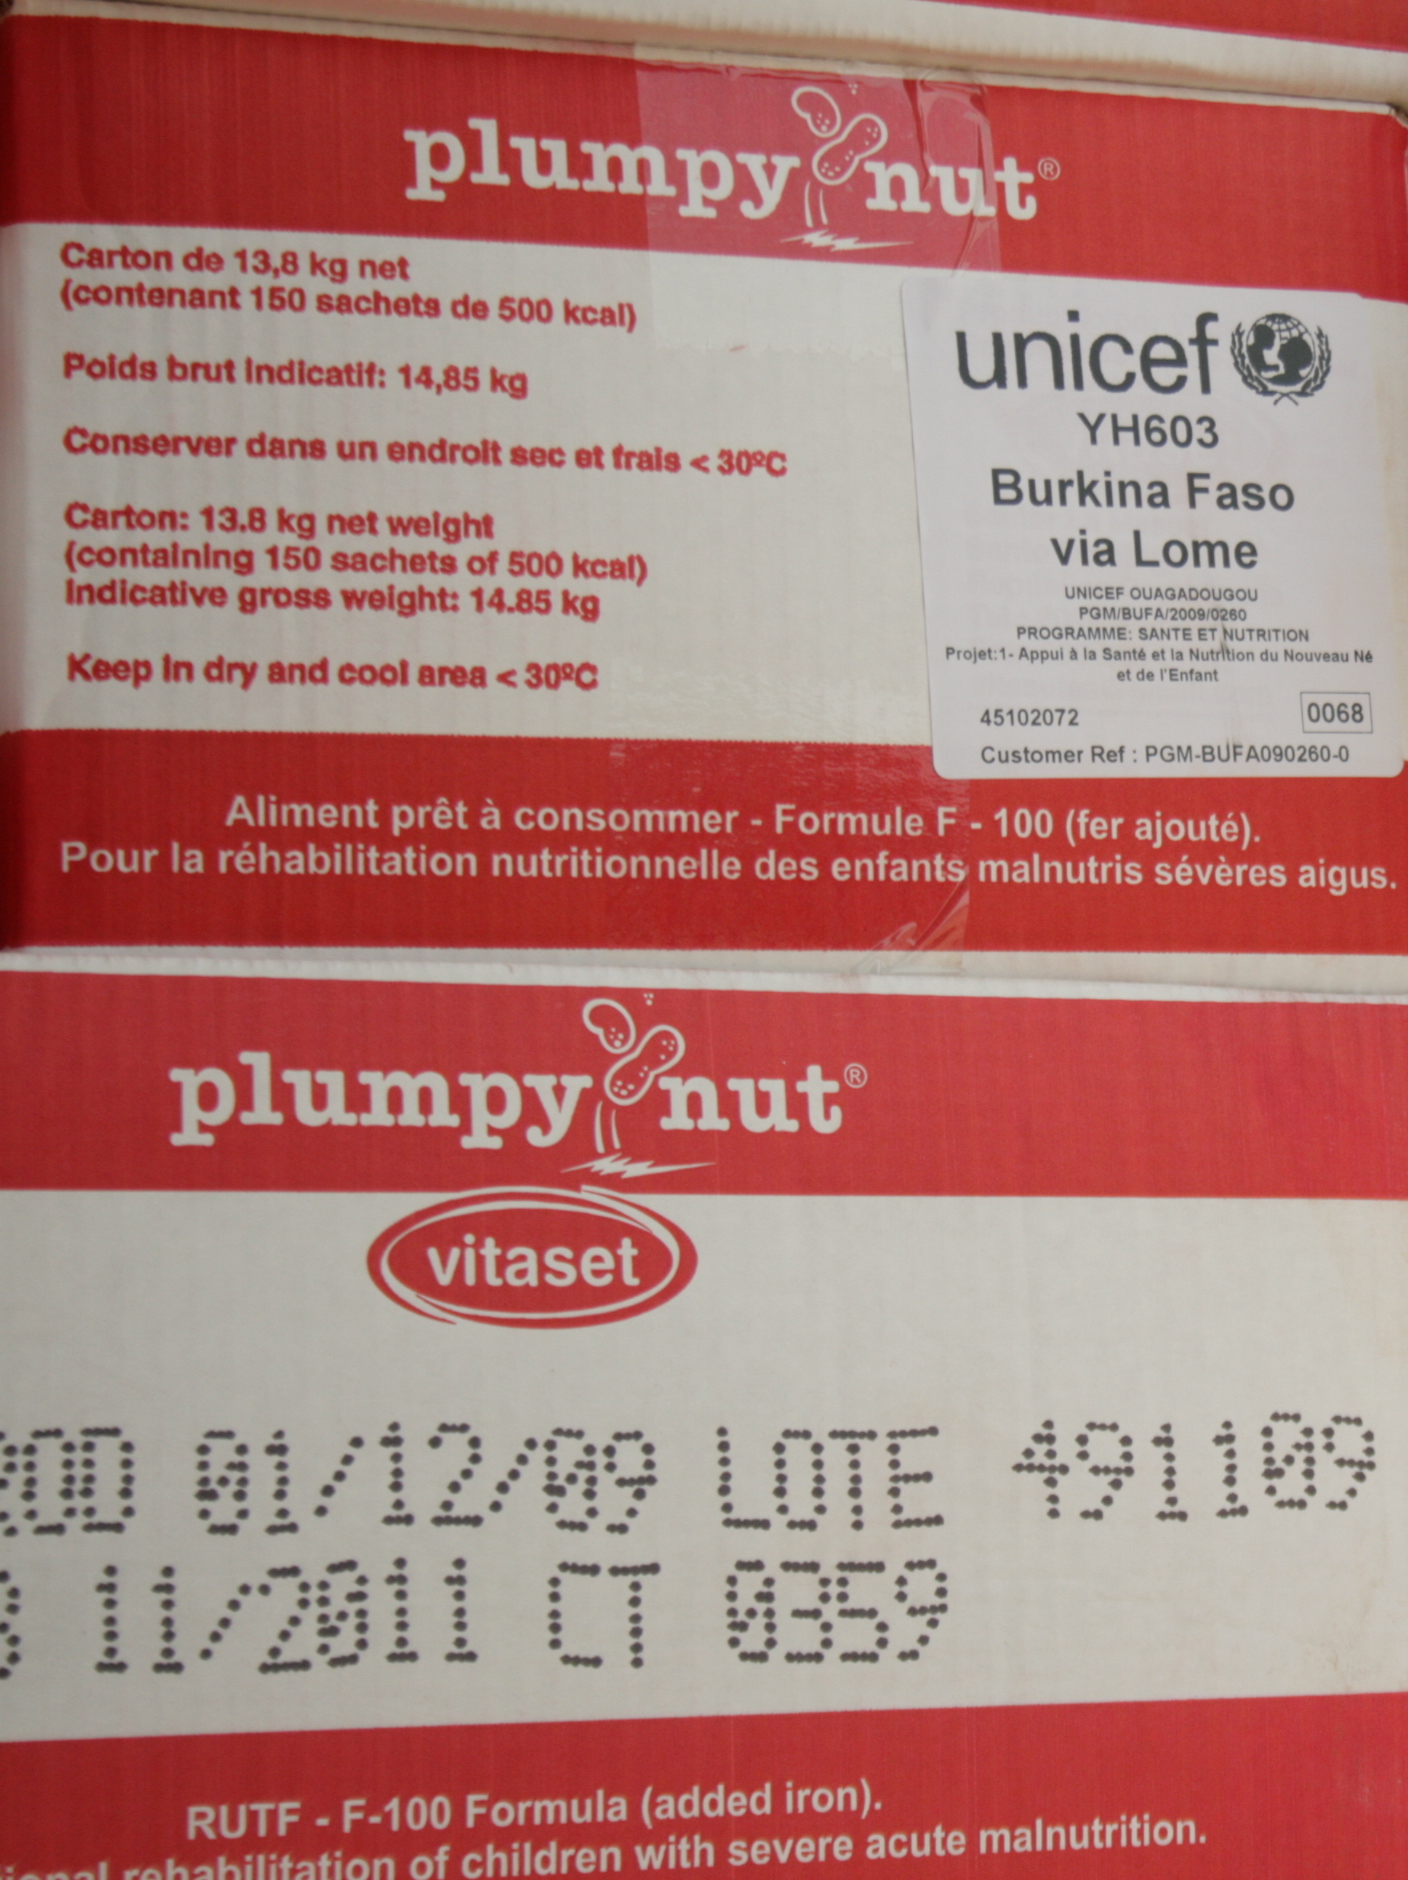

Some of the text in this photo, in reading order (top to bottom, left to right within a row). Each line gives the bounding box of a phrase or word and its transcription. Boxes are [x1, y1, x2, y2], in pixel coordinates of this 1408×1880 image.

[403, 117, 803, 220] plumpy
[60, 241, 411, 284] Carton de 13,8 kg net
[60, 278, 638, 333] (contenant 150 sachets de 500 kcal)
[955, 309, 1219, 395] unicef
[63, 351, 157, 383] Poids
[167, 354, 236, 384] brut
[398, 364, 481, 395] 14,85
[490, 367, 529, 400] kg
[63, 425, 239, 457] Conserver
[246, 432, 328, 461] dans
[336, 440, 379, 462] un
[387, 437, 503, 466] endroit
[510, 445, 566, 468] sec
[575, 445, 605, 470] et
[612, 444, 682, 473] frais
[1077, 412, 1219, 449] YH603
[991, 467, 1295, 512] Burkina Faso
[64, 501, 495, 545] Carton: 13.8 kg net weight
[65, 540, 648, 586] (containing 150 sachets of 500 kcal)
[1050, 528, 1258, 569] via Lome
[66, 578, 601, 623] Indicative gross weight: 14.85 kg
[1064, 585, 1259, 602] UNICEF OUAGADOUGOU
[1078, 606, 1247, 622] PGM/BUFA/2009/0260
[1016, 626, 1310, 643] PROGRAMME: SANTE ET NUTRITION
[1018, 646, 1064, 664] Appui
[1069, 647, 1079, 661] à
[1083, 647, 1097, 661] la
[1102, 646, 1147, 662] Santé
[1151, 648, 1166, 662] et
[1170, 647, 1184, 662] la
[1188, 647, 1255, 662] Nutrition
[1259, 648, 1279, 663] du
[1283, 648, 1350, 663] Nouveau
[1353, 649, 1374, 664] Né
[67, 653, 154, 689] Keep
[203, 655, 259, 691] dry
[268, 657, 330, 685] and
[338, 659, 410, 687] cool
[418, 664, 488, 688] area
[1116, 667, 1219, 682] et de l'Enfant
[979, 707, 1079, 727] 45102072
[1307, 702, 1365, 724] 0068
[980, 745, 1084, 765] Customer
[1090, 744, 1126, 764] Ref
[1145, 742, 1350, 763] PGM-BUFA090260-0
[225, 794, 380, 829] Aliment
[392, 796, 469, 837] prêt
[480, 798, 502, 830] à
[514, 806, 740, 834] consommer
[775, 803, 925, 837] Formule
[937, 805, 959, 837] F
[994, 807, 1055, 839] 100
[1065, 808, 1125, 847] (fer
[1134, 810, 1261, 850] ajouté).
[62, 840, 1398, 897] Pour la réhabilitation nutritionnelle des enfants malnutris sévères aigus.
[169, 1050, 595, 1150] plumpy
[427, 1233, 641, 1287] vitaset
[194, 1421, 658, 1537] 01/12/09
[716, 1425, 945, 1532] LOTE
[1011, 1411, 1376, 1523] 491109
[94, 1557, 478, 1675] 11/2011
[547, 1561, 661, 1669] CT
[724, 1558, 948, 1664] 0359
[187, 1800, 302, 1840] RUTF
[343, 1794, 453, 1833] F-100
[466, 1788, 629, 1828] Formula
[641, 1781, 773, 1829] (added
[785, 1778, 883, 1819] iron).
[409, 1844, 452, 1880] of
[461, 1840, 623, 1880] children
[634, 1833, 716, 1871] with
[728, 1834, 855, 1867] severe
[865, 1824, 968, 1860] acute
[979, 1813, 1207, 1854] malnutrition.
